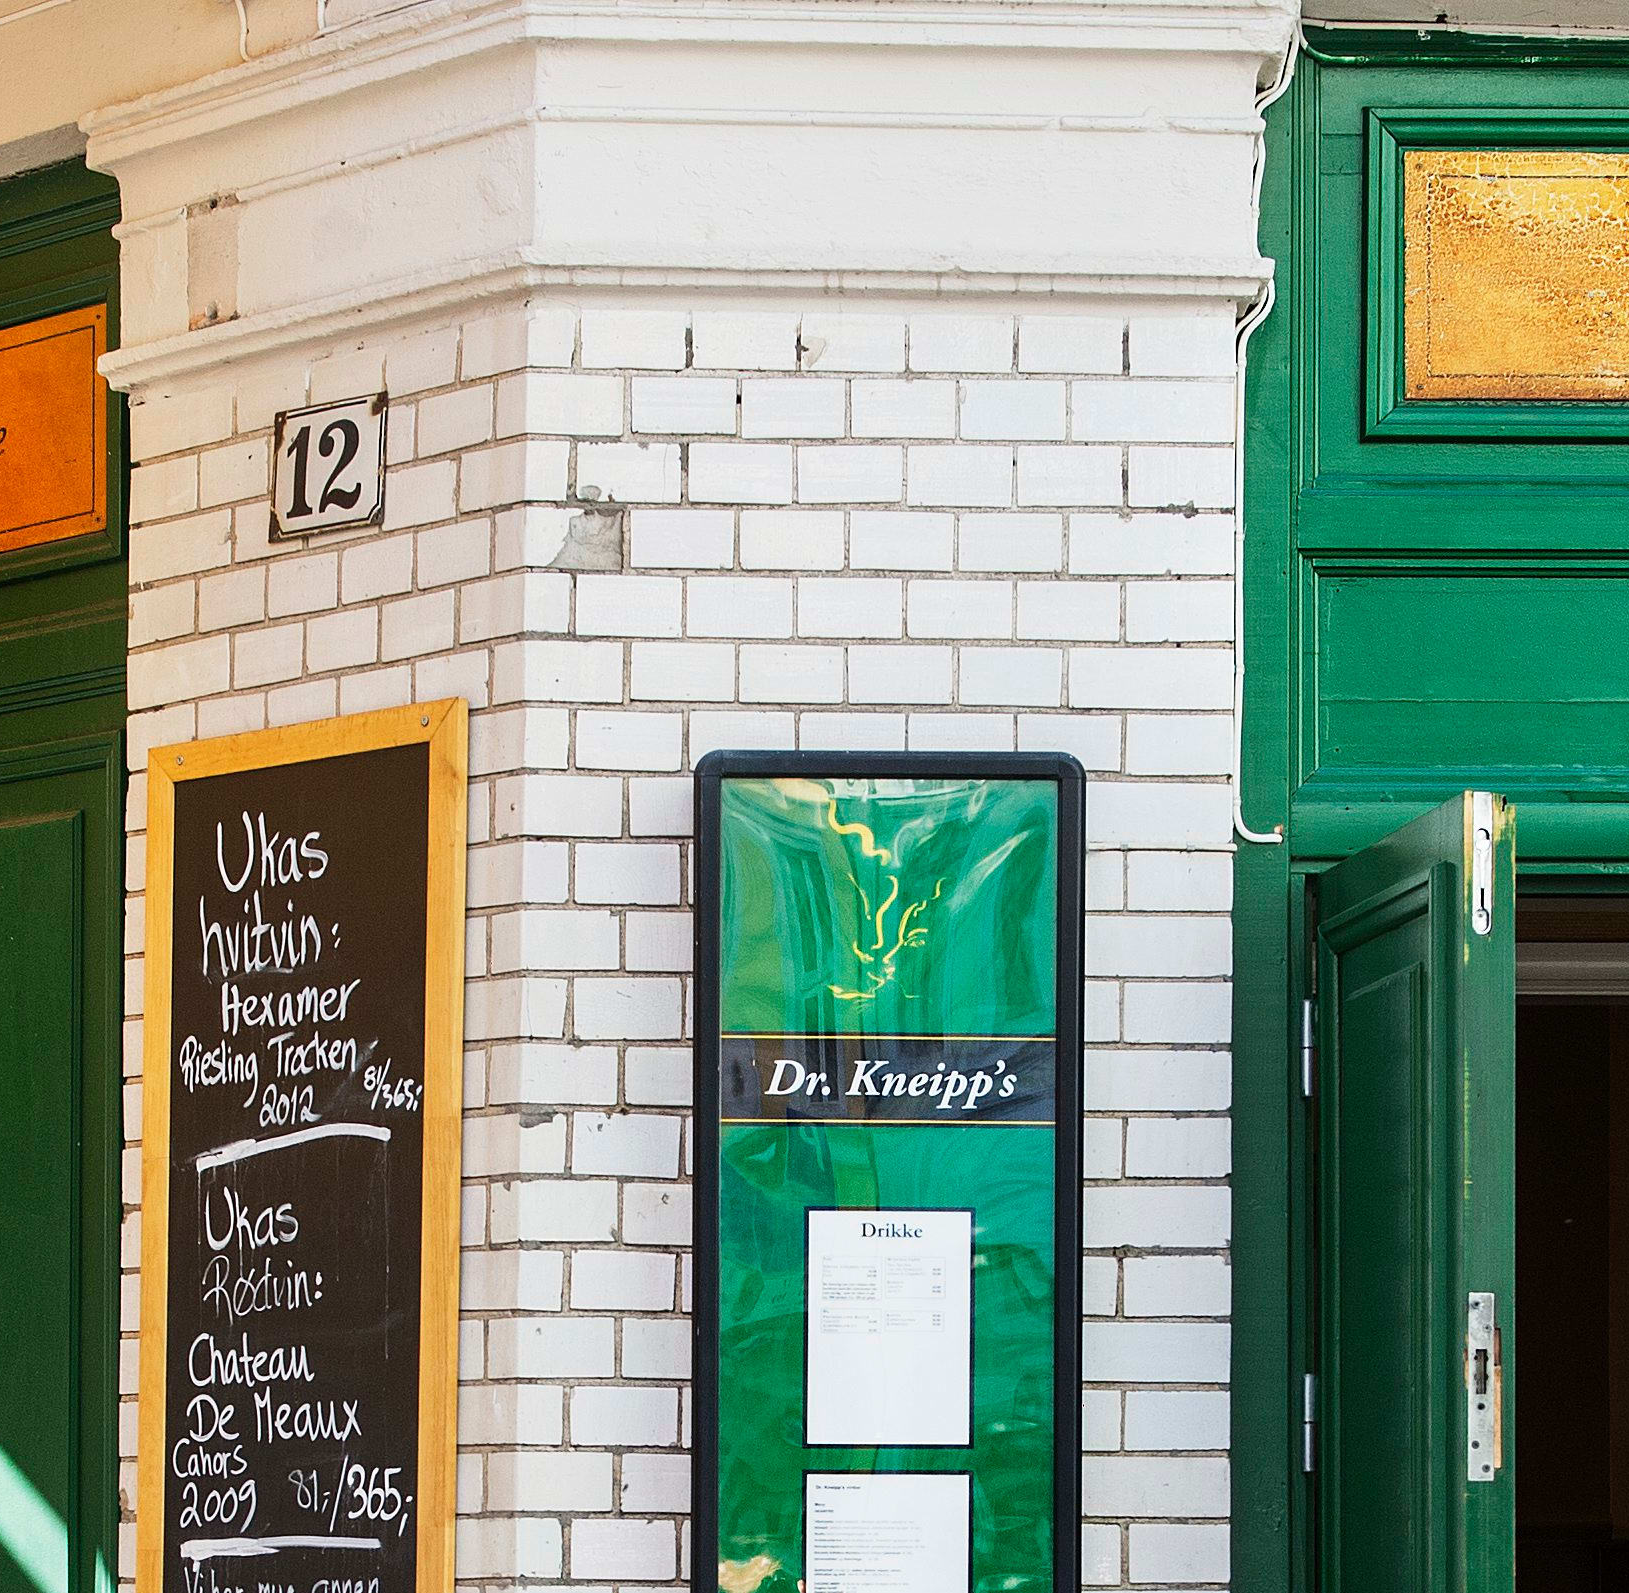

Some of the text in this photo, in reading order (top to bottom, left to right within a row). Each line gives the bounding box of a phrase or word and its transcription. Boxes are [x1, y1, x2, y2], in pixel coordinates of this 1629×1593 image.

[286, 418, 362, 519] 12
[216, 810, 329, 893] Ukas
[220, 978, 362, 1037] Hexamer
[179, 1035, 259, 1109] Riesling
[764, 1059, 1018, 1110] Dr. Kneipp's
[259, 1083, 323, 1128] 2012
[203, 1186, 300, 1252] Ukas
[860, 1222, 923, 1239] Drikke
[187, 1331, 315, 1388] Chateau
[186, 1386, 363, 1443] De Meaux
[172, 1437, 248, 1479] Cahors
[179, 1479, 257, 1533] 2009
